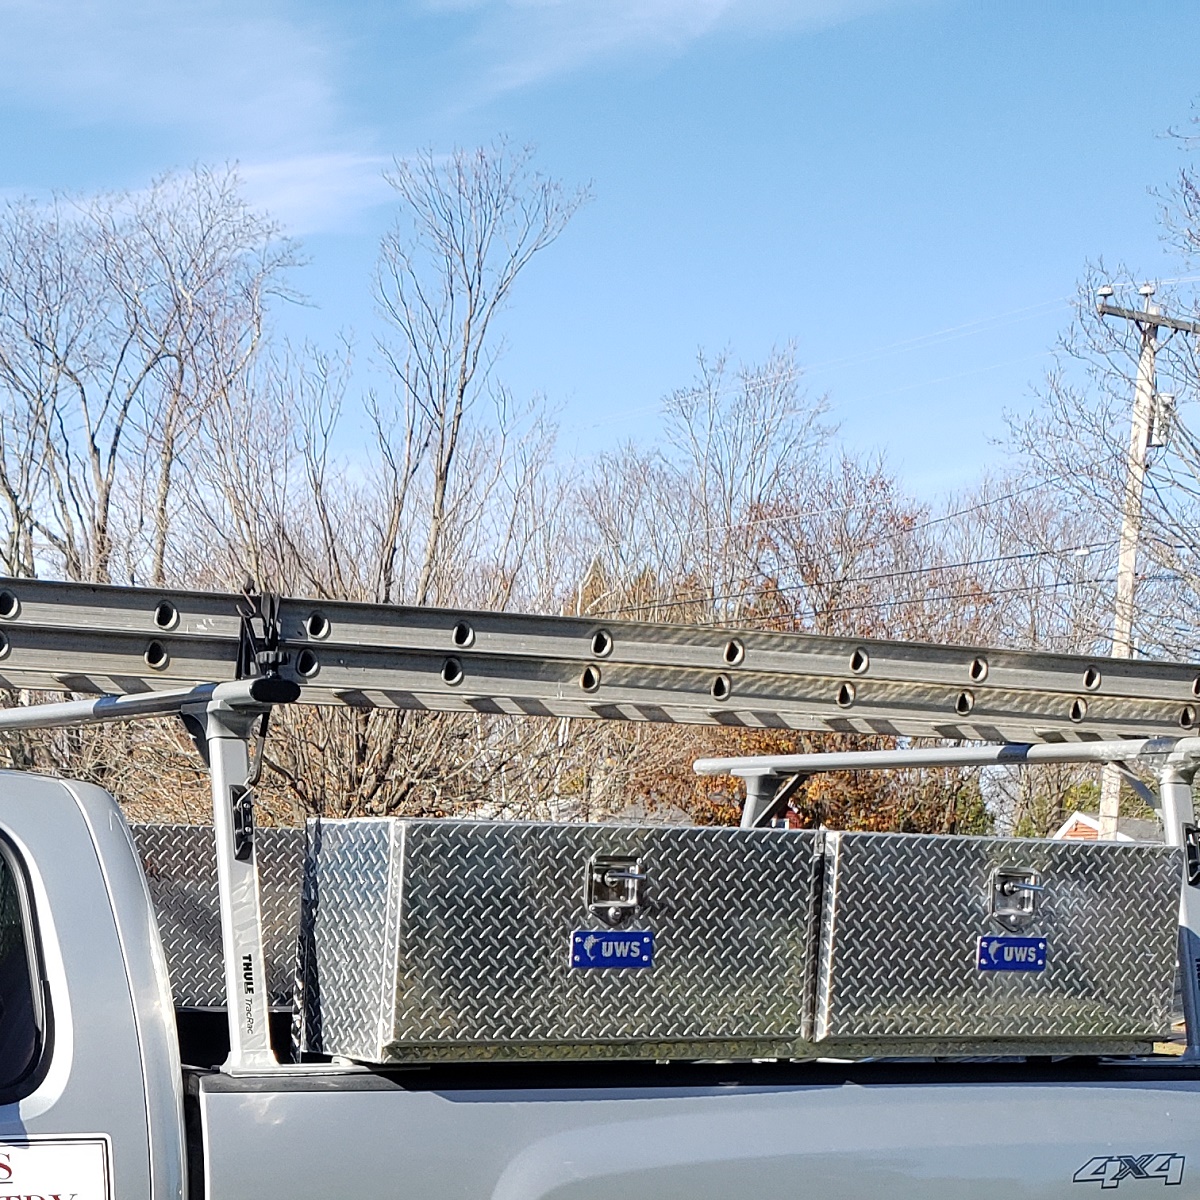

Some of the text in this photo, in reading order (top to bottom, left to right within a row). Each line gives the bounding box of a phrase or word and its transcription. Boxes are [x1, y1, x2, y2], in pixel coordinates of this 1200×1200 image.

[601, 941, 641, 957] UWS
[1003, 946, 1036, 962] UWS
[242, 954, 254, 1035] THULE TracRac
